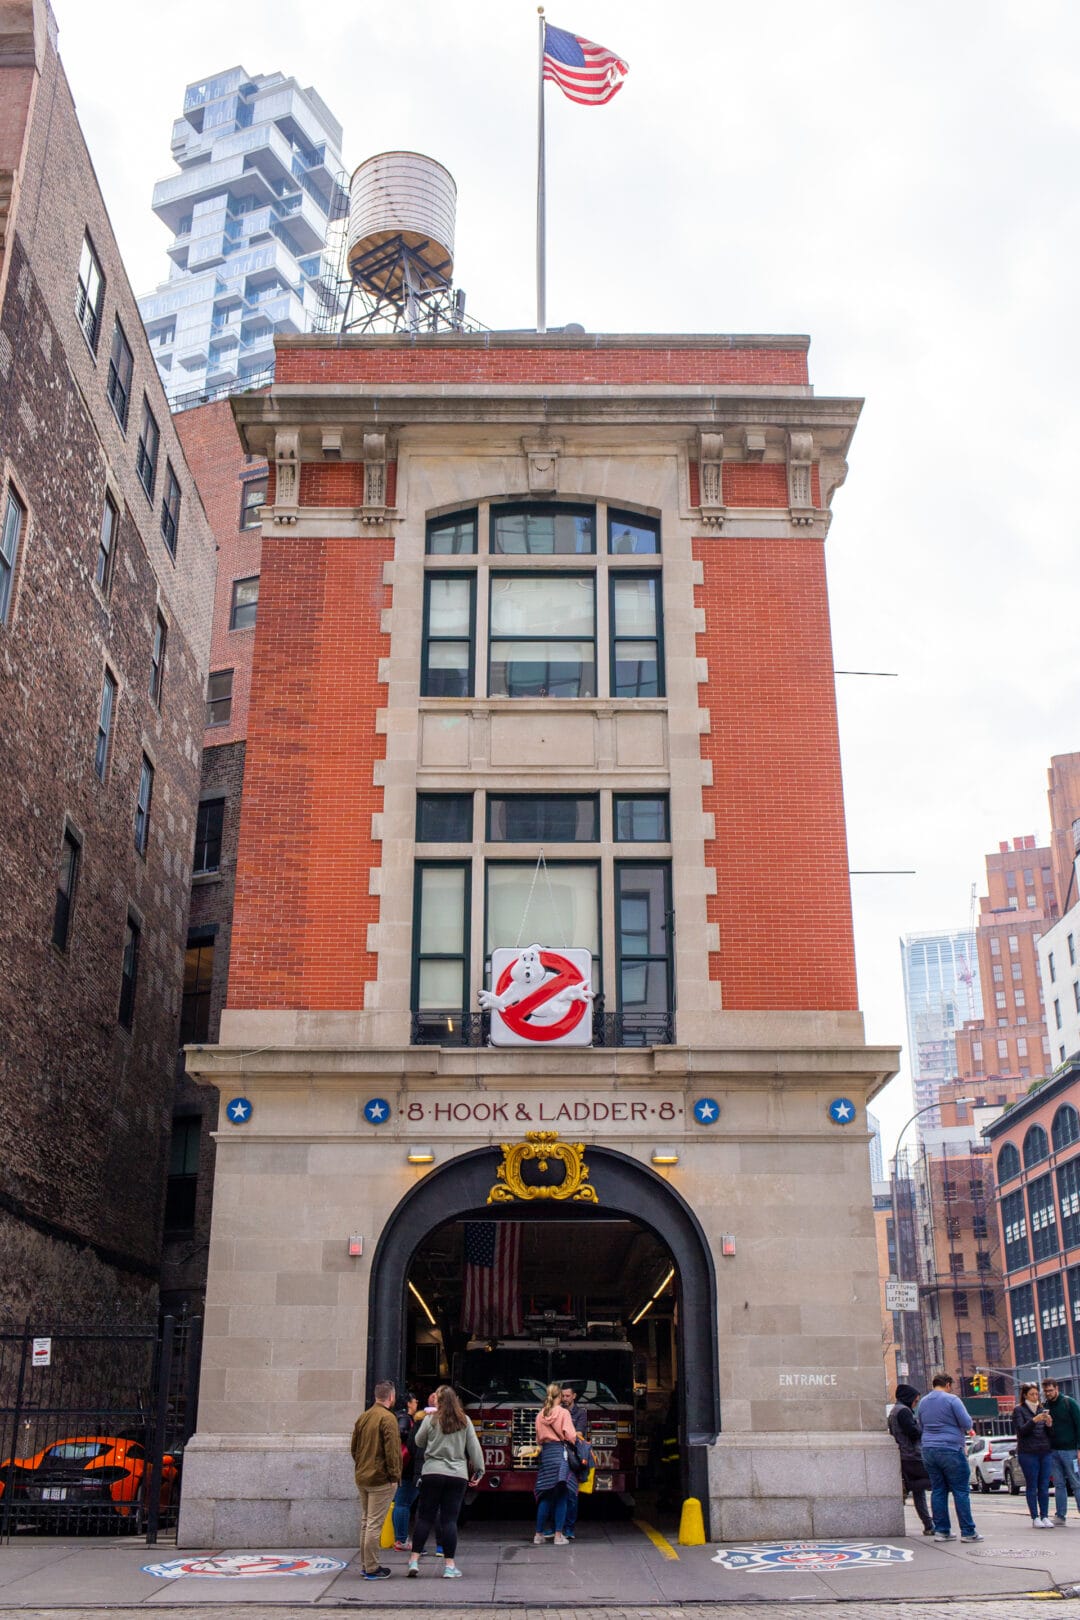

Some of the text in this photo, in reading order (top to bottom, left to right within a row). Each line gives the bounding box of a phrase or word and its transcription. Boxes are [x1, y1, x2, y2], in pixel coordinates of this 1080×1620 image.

[434, 1102, 510, 1121] HOOK
[515, 1102, 533, 1121] &
[539, 1102, 647, 1121] LADDER
[779, 1374, 837, 1386] ENTRANCE
